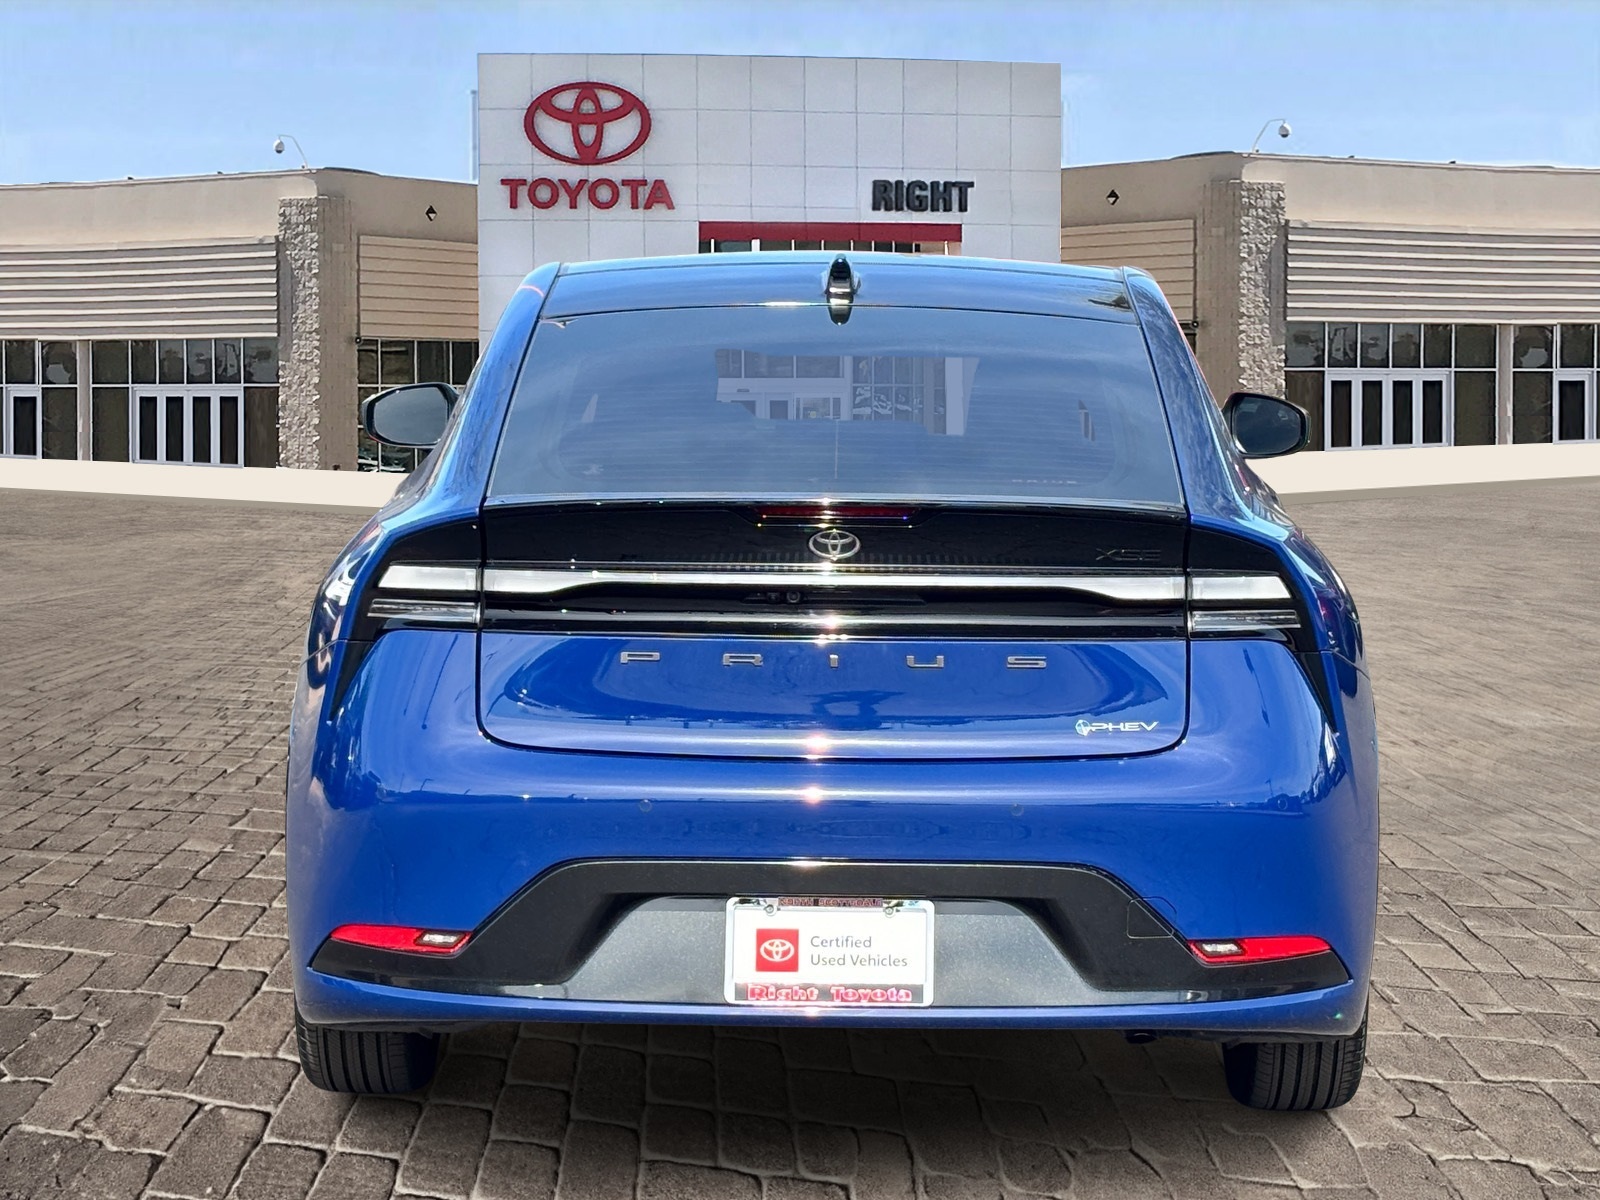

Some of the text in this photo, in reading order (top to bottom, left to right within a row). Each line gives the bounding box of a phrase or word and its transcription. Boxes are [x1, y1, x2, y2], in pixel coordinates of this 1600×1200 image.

[501, 179, 675, 209] TOYOTA
[872, 180, 975, 213] RIGHT
[620, 651, 1047, 669] PRIUS
[1090, 721, 1159, 732] PHEV
[810, 936, 872, 948] Certified
[810, 954, 908, 967] Used Vehicles
[747, 983, 913, 1002] Right Toyota
